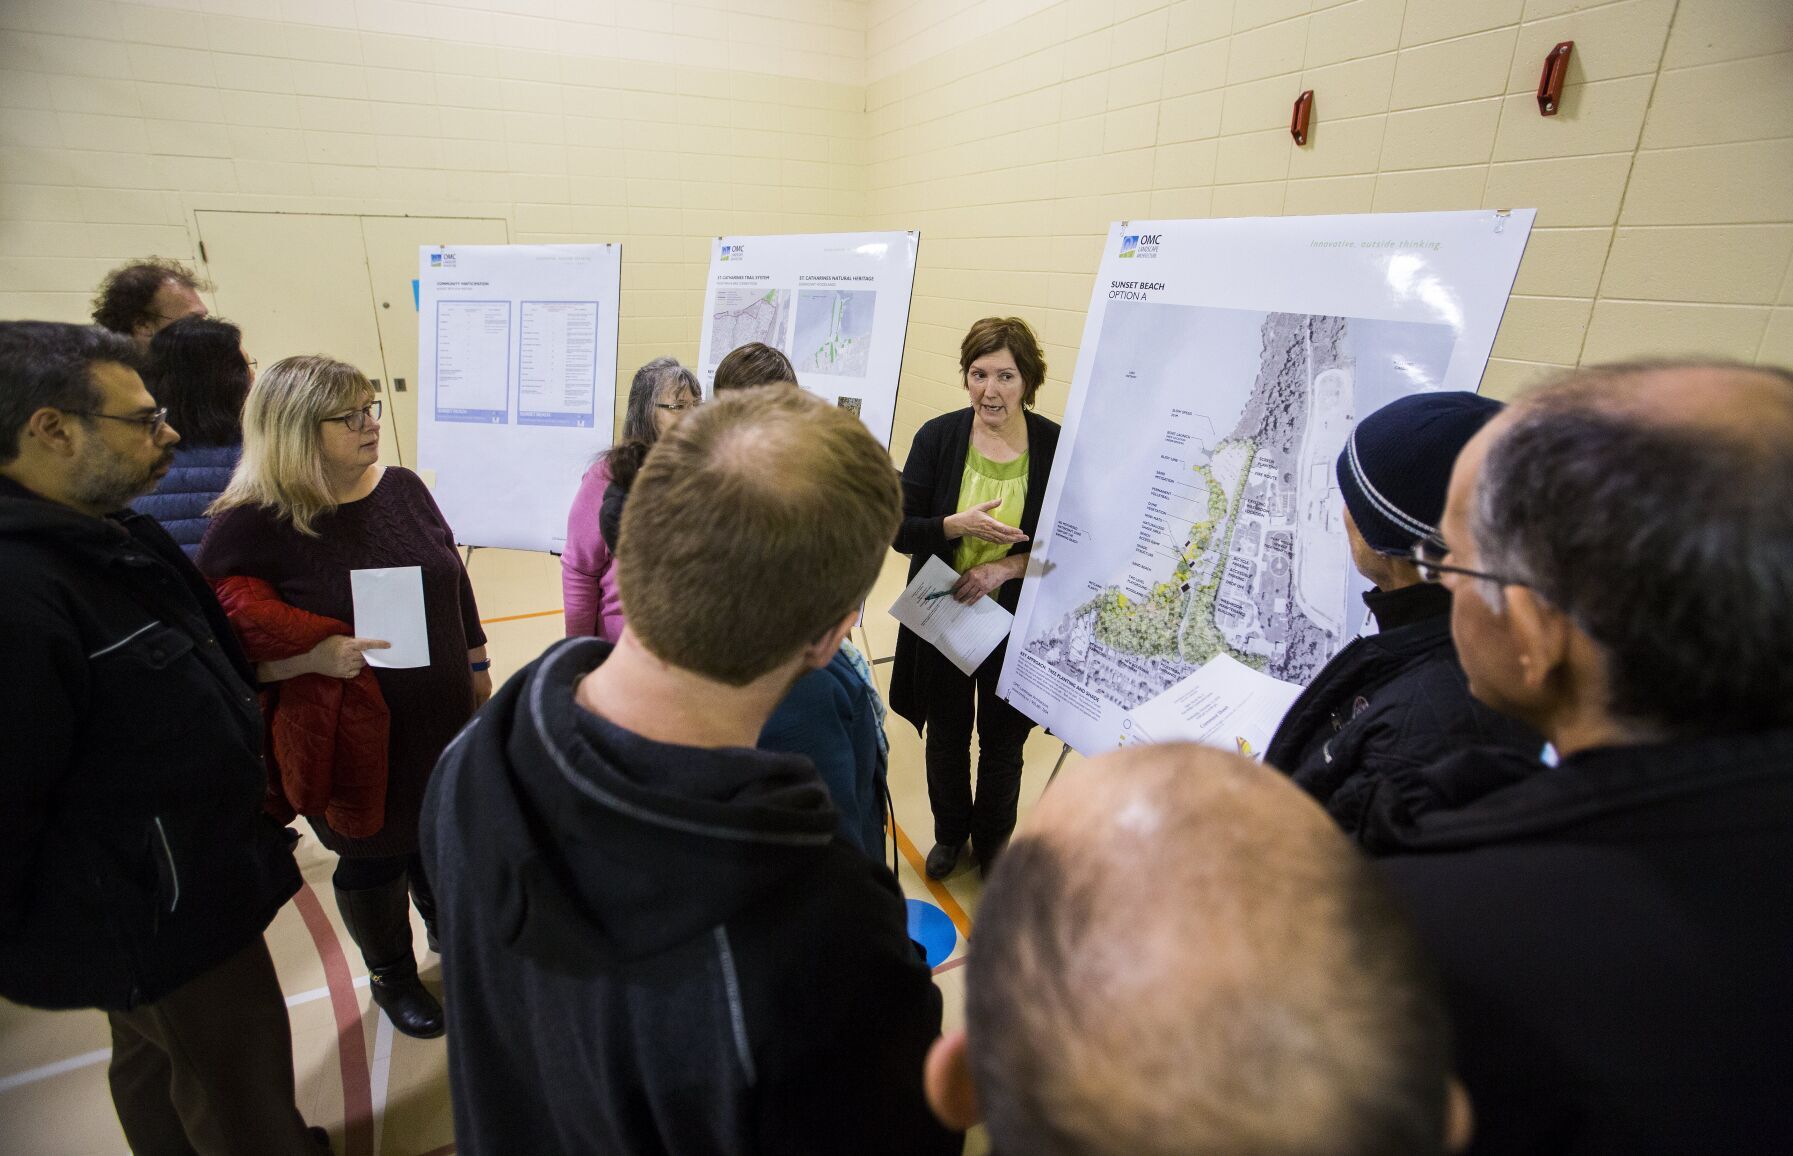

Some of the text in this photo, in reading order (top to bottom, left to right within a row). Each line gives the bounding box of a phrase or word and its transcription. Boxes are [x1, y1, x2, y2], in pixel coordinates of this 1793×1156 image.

[1140, 234, 1162, 244] OMC
[1360, 240, 1396, 248] outside
[1111, 281, 1165, 290] SUNSET BEACH
[1108, 290, 1147, 300] OPTION A
[1057, 673, 1077, 688] PLANTING
